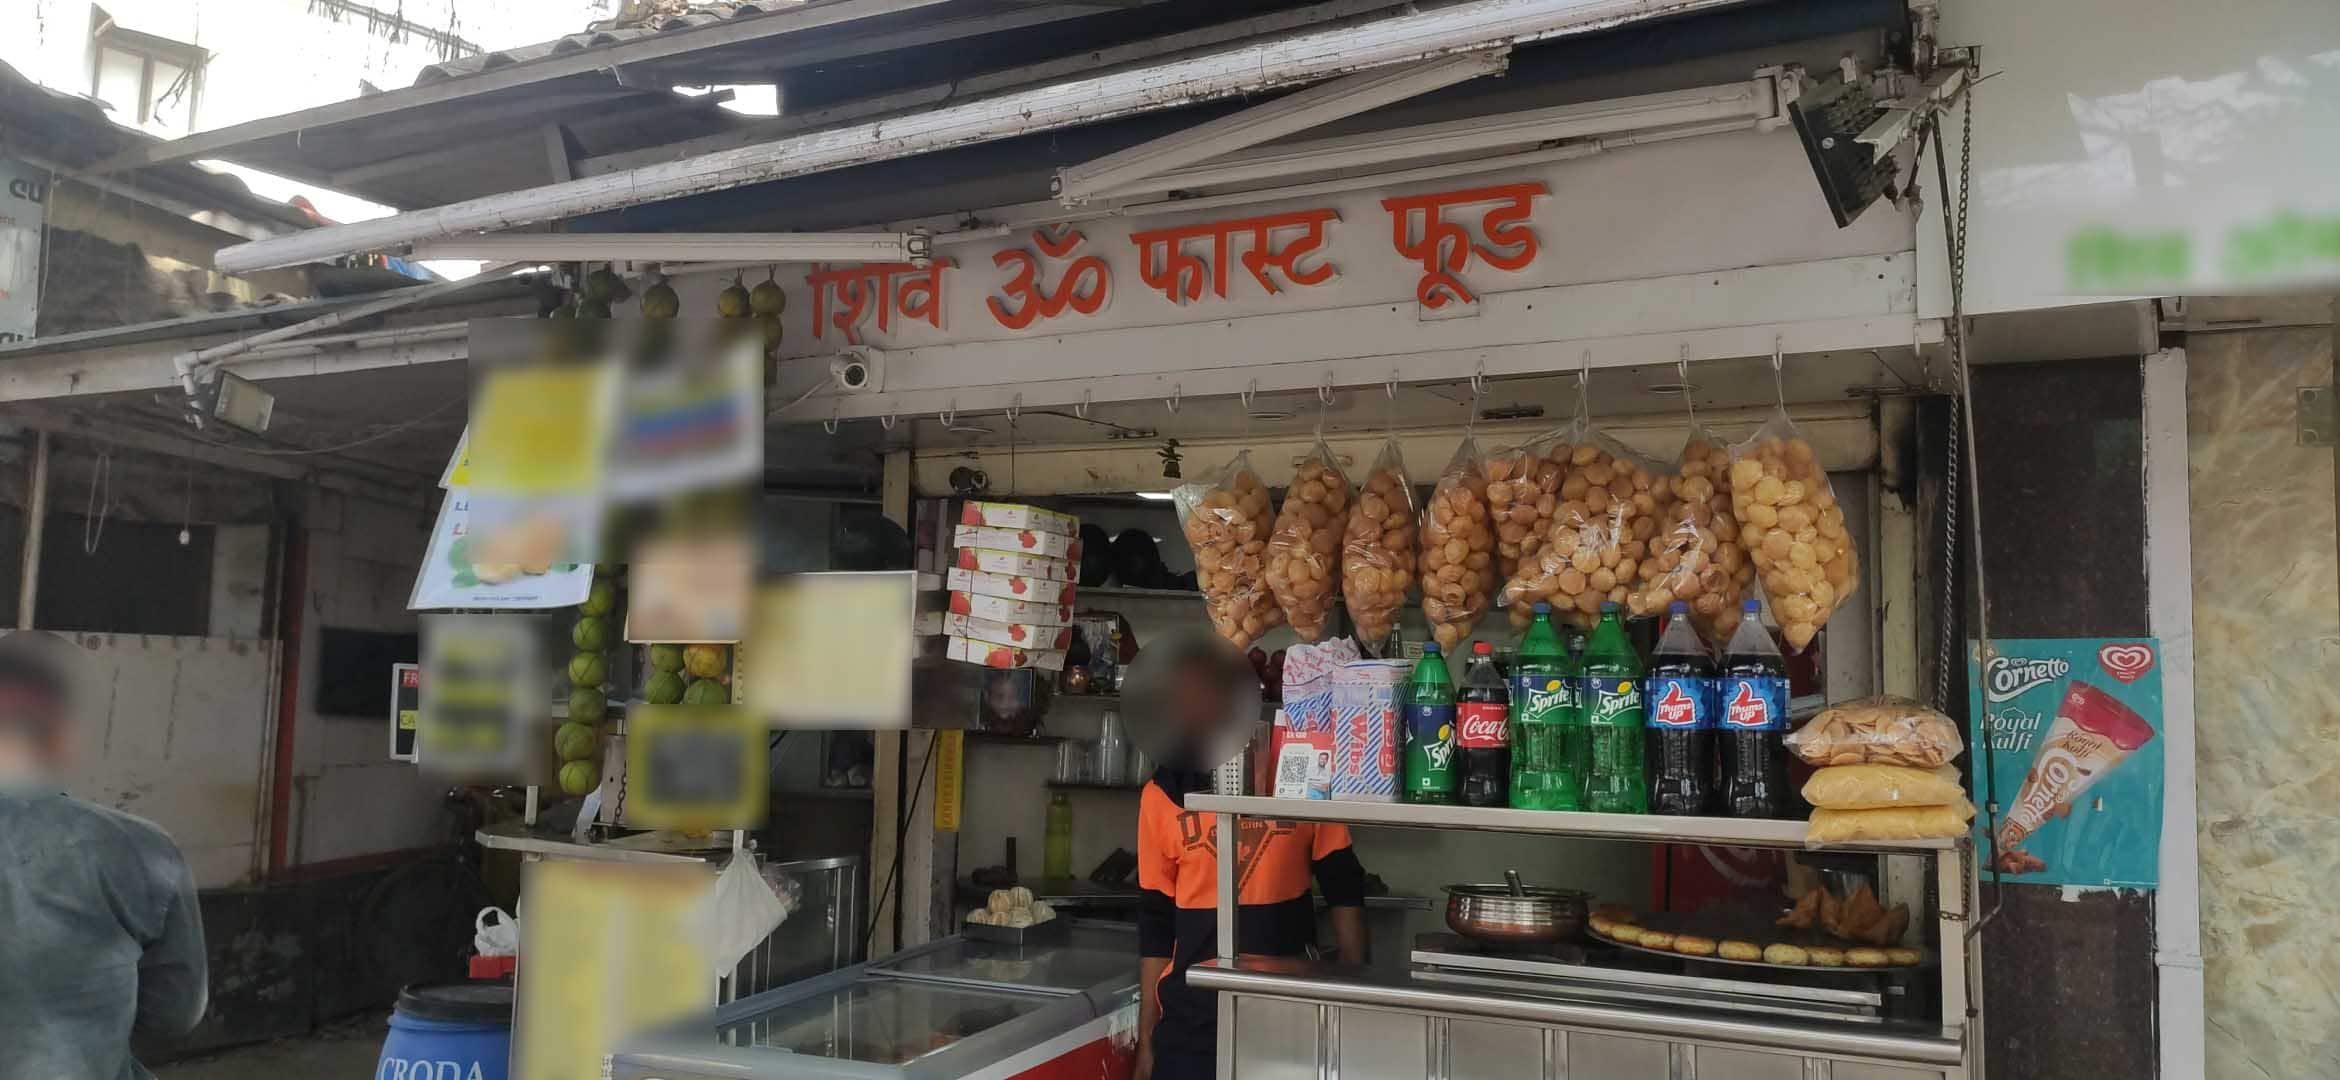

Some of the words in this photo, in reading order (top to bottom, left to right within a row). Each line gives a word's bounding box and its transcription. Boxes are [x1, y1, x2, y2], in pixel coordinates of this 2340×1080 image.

[1129, 208, 1339, 303] फास्ट
[1380, 182, 1548, 309] फूड
[1987, 657, 2069, 702] Cornetto
[1529, 686, 1570, 713] Sprite
[1600, 688, 1640, 715] Sprite
[1660, 702, 1691, 714] Thums
[1731, 703, 1763, 716] Thums
[1350, 711, 1368, 776] Wibs
[380, 1056, 483, 1080] CRODA
